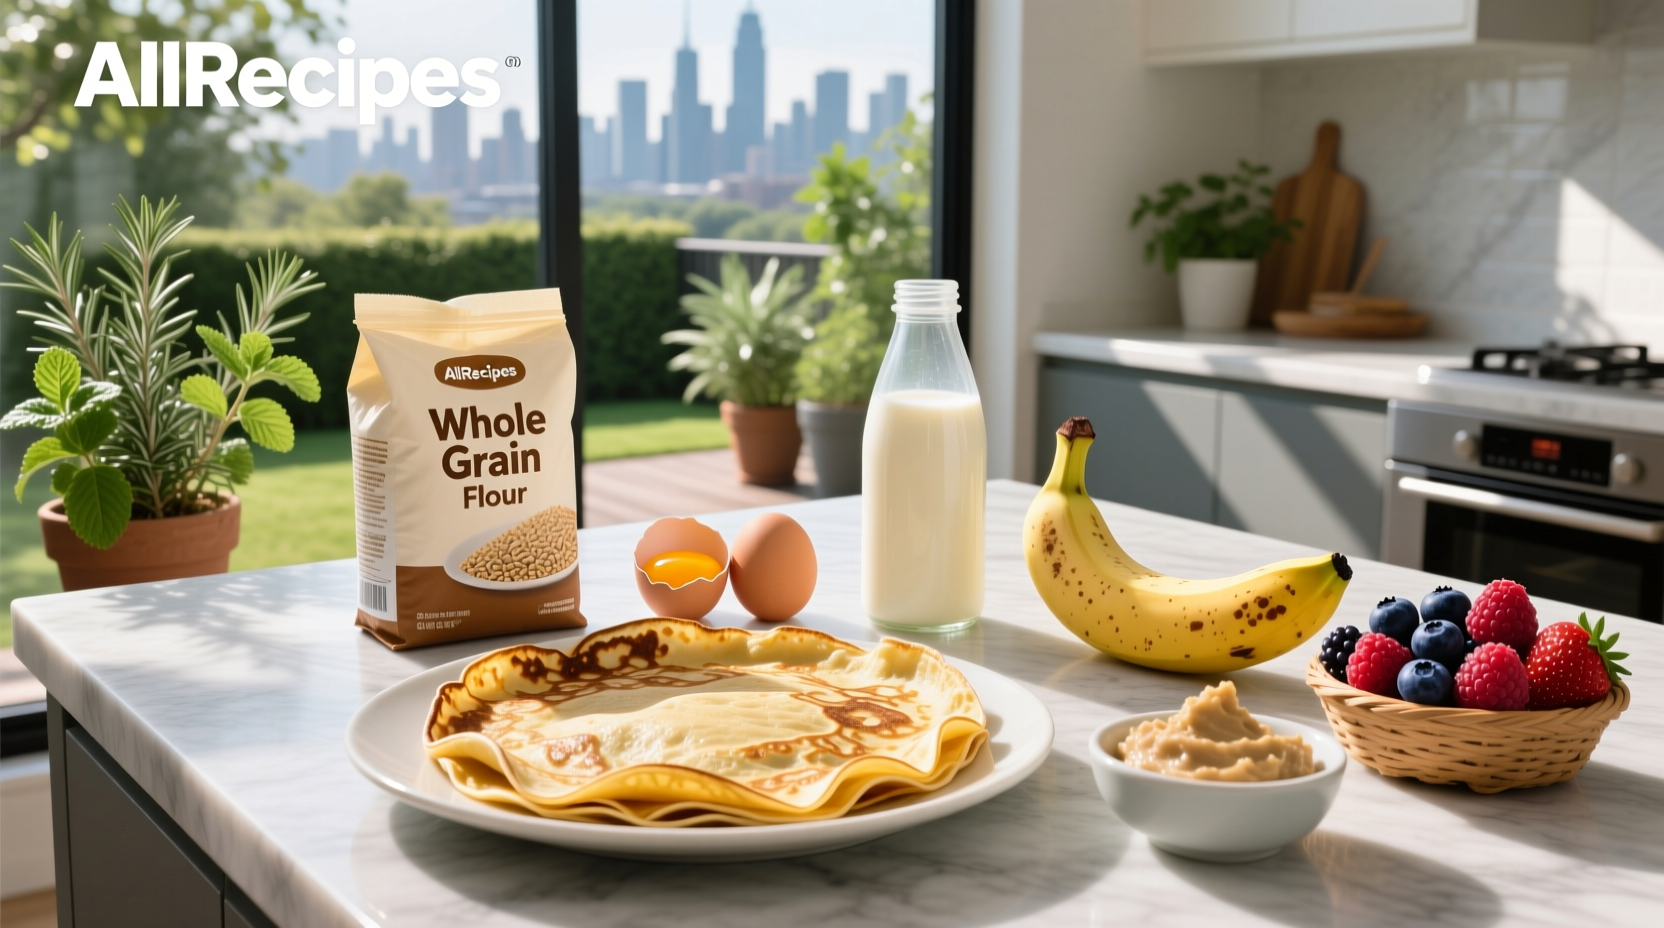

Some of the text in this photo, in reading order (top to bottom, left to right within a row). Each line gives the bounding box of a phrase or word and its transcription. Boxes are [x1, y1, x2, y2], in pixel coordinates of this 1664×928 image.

[444, 365, 517, 382] AllRecipes
[428, 402, 546, 441] Whole
[442, 440, 541, 480] Grain
[463, 484, 528, 509] Flour
